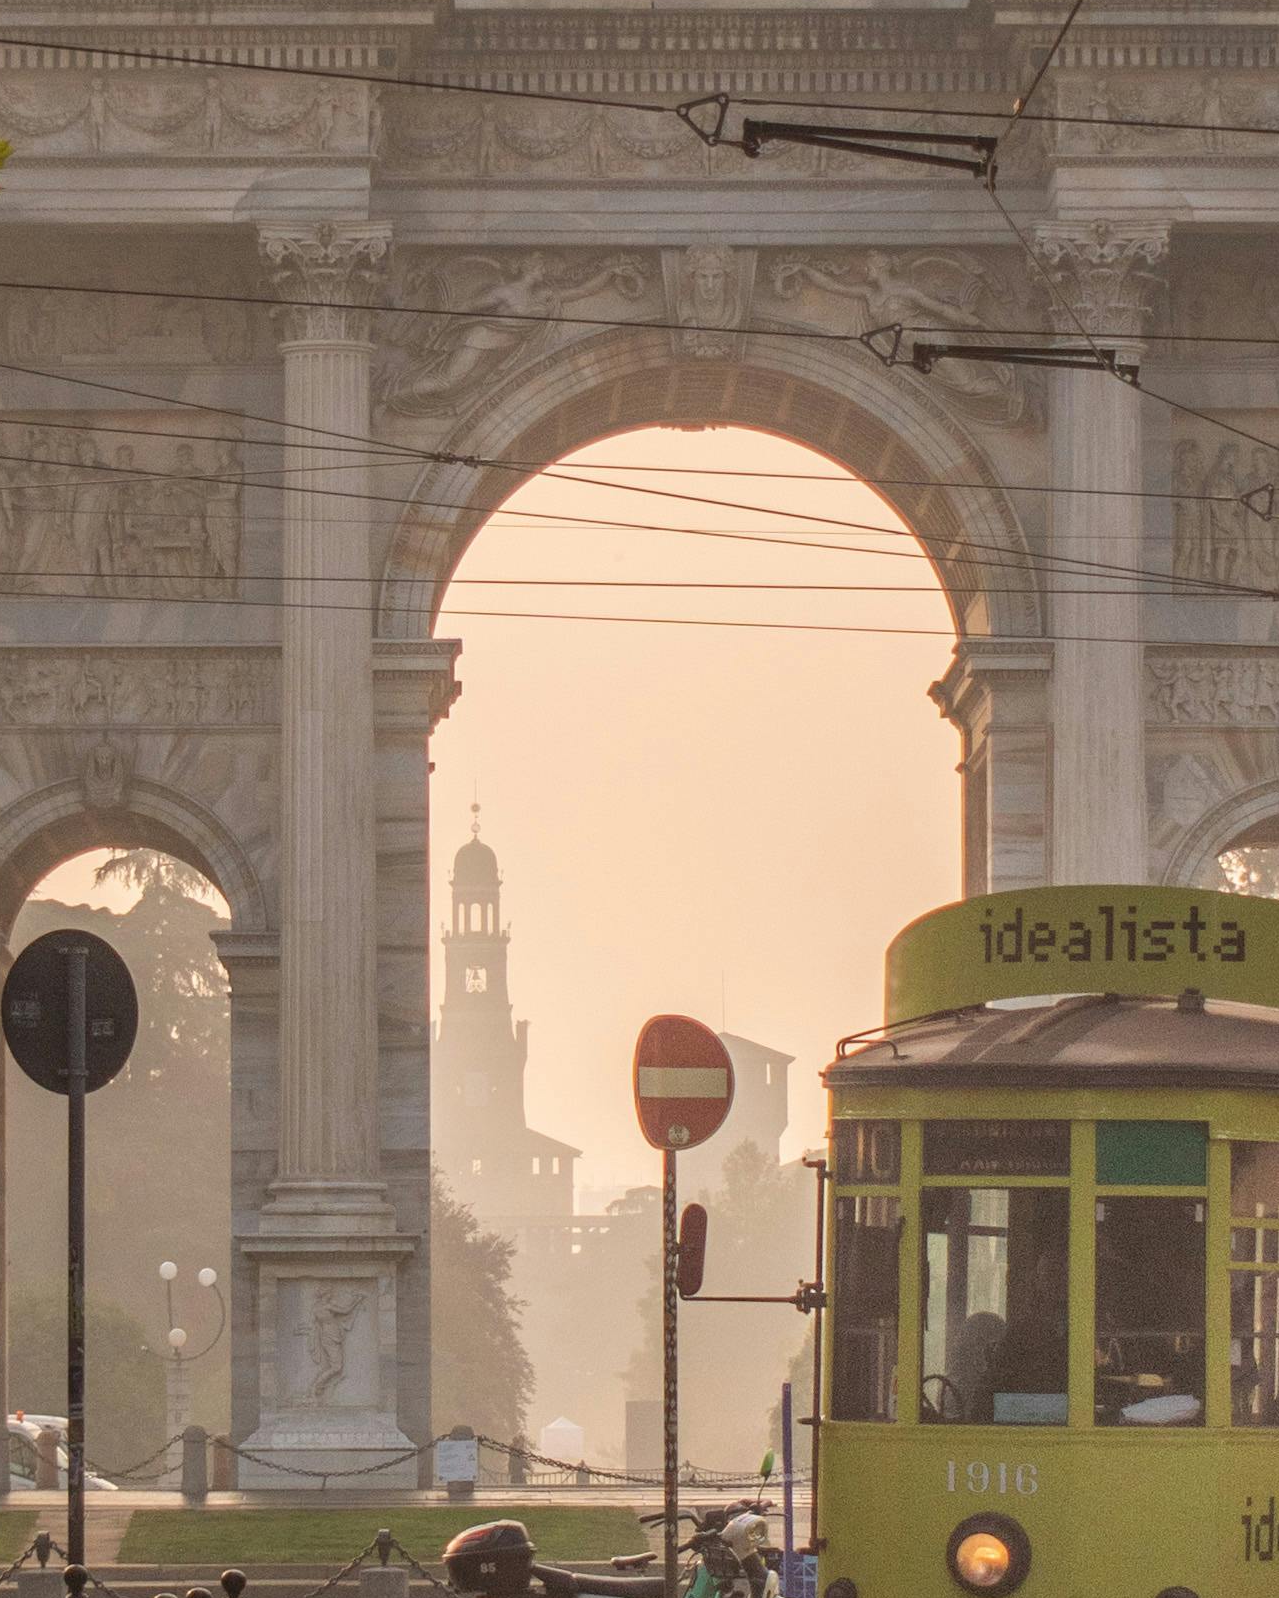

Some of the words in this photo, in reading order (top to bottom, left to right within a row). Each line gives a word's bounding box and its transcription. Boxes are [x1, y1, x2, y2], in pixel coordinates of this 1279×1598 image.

[979, 905, 1246, 963] idealista
[947, 1460, 1039, 1494] 1916
[480, 1562, 497, 1573] 85
